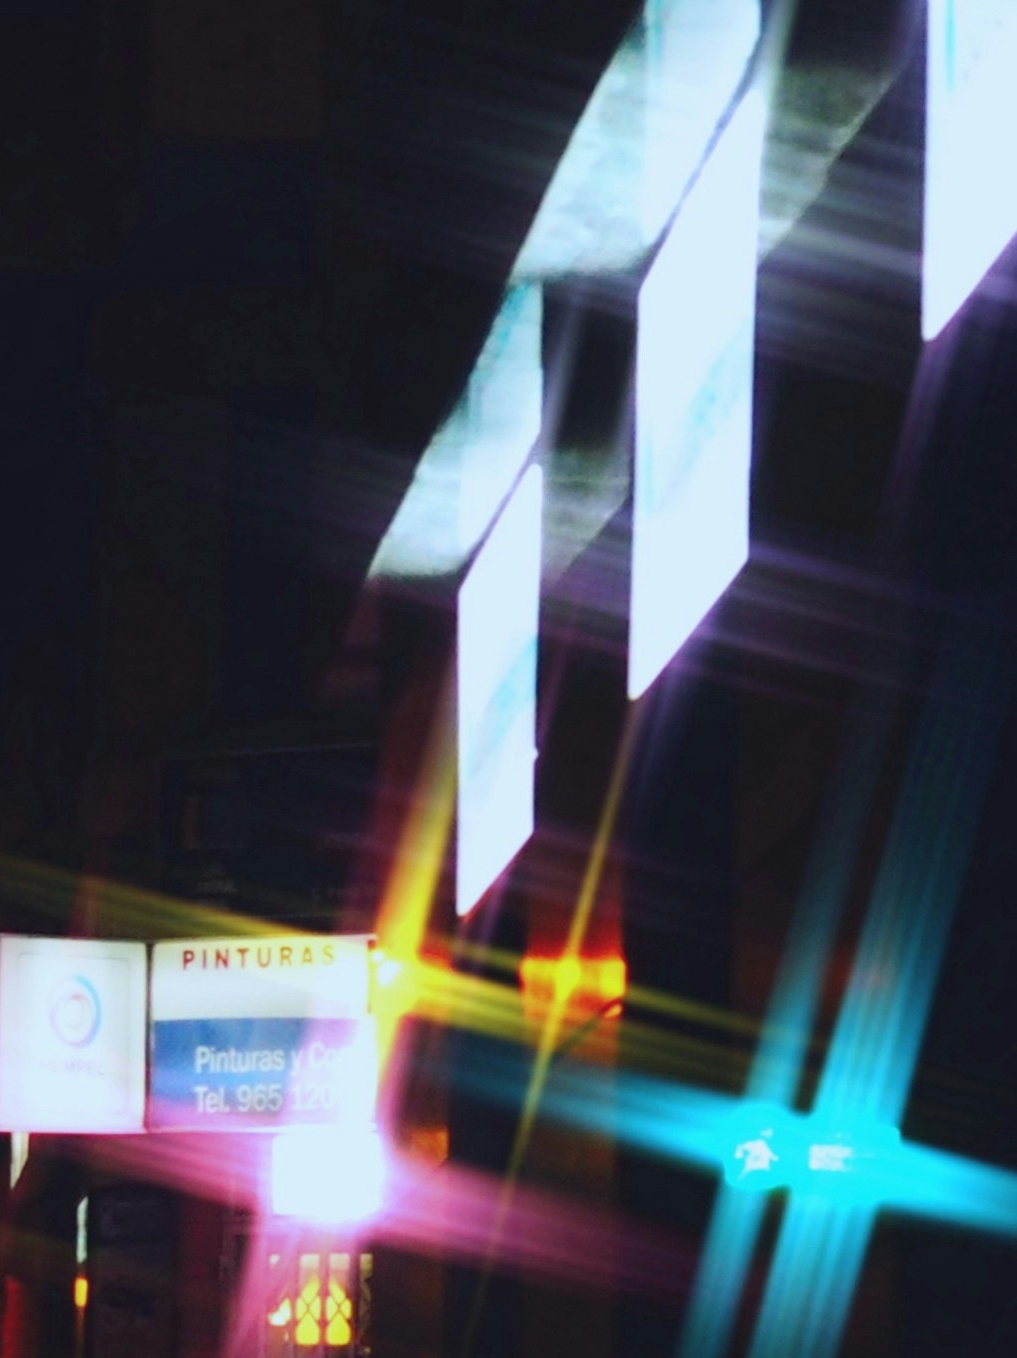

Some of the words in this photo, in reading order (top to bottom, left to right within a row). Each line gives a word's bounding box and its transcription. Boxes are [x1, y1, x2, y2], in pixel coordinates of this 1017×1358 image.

[183, 943, 335, 970] PINTURAS
[194, 1045, 285, 1075] Pinturas
[290, 1050, 304, 1077] y
[194, 1085, 231, 1114] Tel.
[236, 1083, 283, 1112] 965
